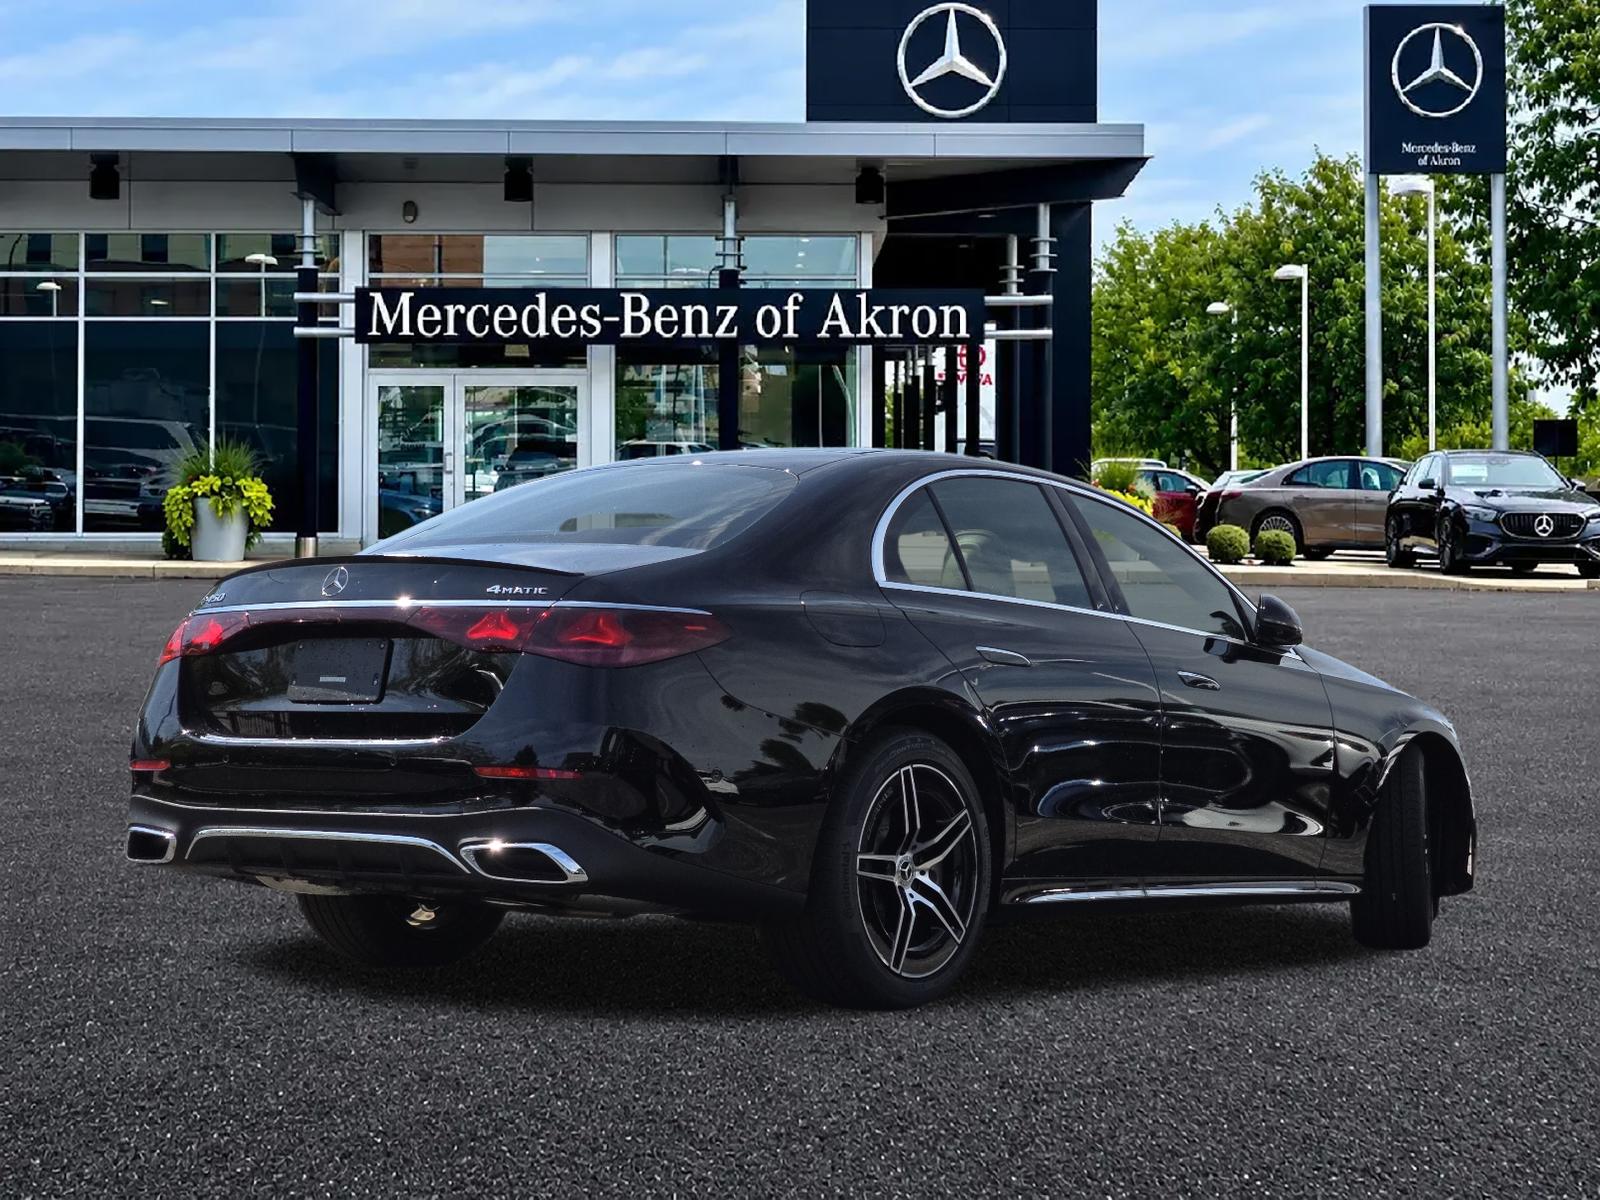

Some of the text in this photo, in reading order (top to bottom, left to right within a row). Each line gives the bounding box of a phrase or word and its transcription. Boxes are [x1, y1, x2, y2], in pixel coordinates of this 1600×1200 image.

[1401, 141, 1477, 154] Mercedes-Benz
[1417, 154, 1461, 166] of Akron
[367, 291, 970, 338] Mercedes-Benz of Akron
[486, 584, 549, 595] 4MATIC
